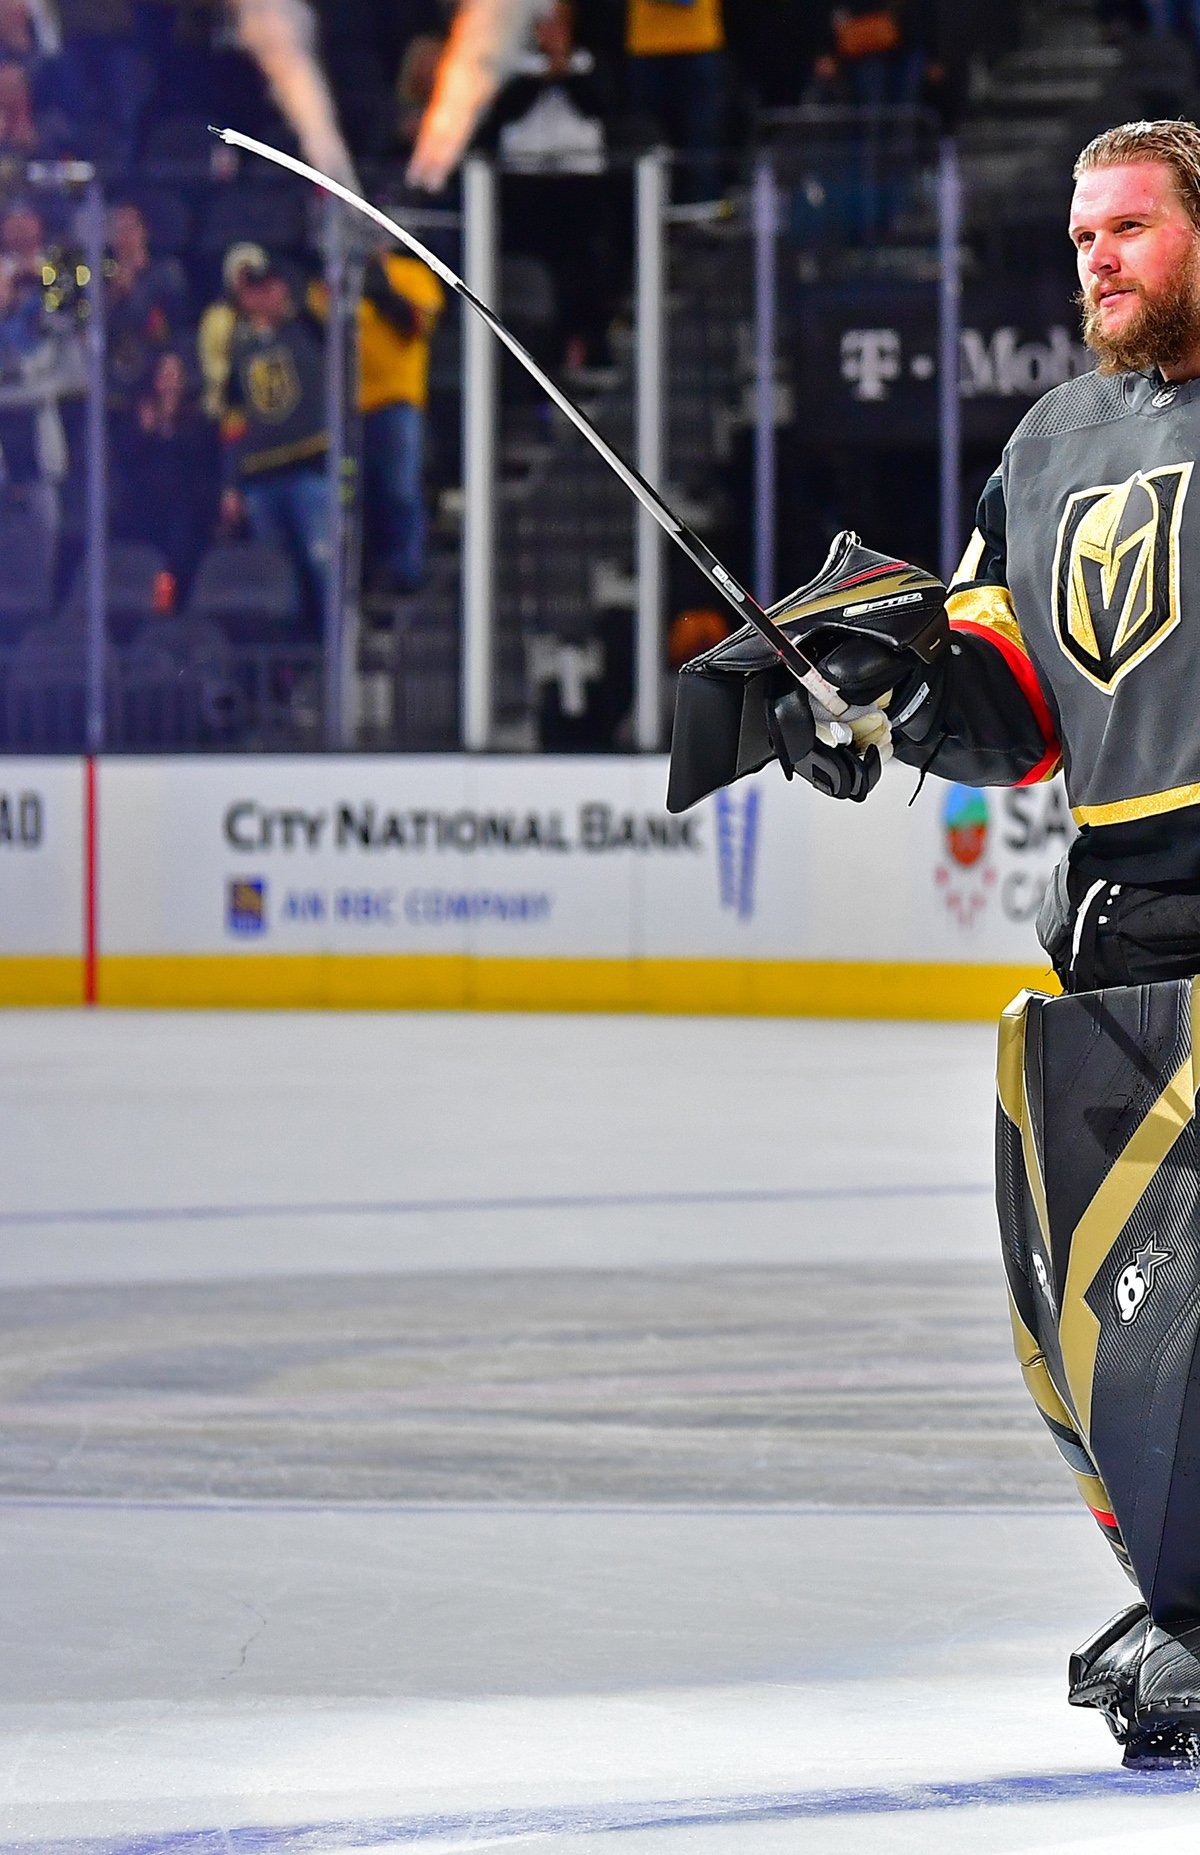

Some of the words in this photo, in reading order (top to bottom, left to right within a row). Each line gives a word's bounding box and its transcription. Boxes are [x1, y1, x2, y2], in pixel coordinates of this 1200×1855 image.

[226, 799, 326, 851] CITY
[336, 799, 568, 851] NATIONAL
[579, 800, 703, 851] BANK
[282, 887, 326, 921] AN
[403, 890, 552, 924] COMPANY
